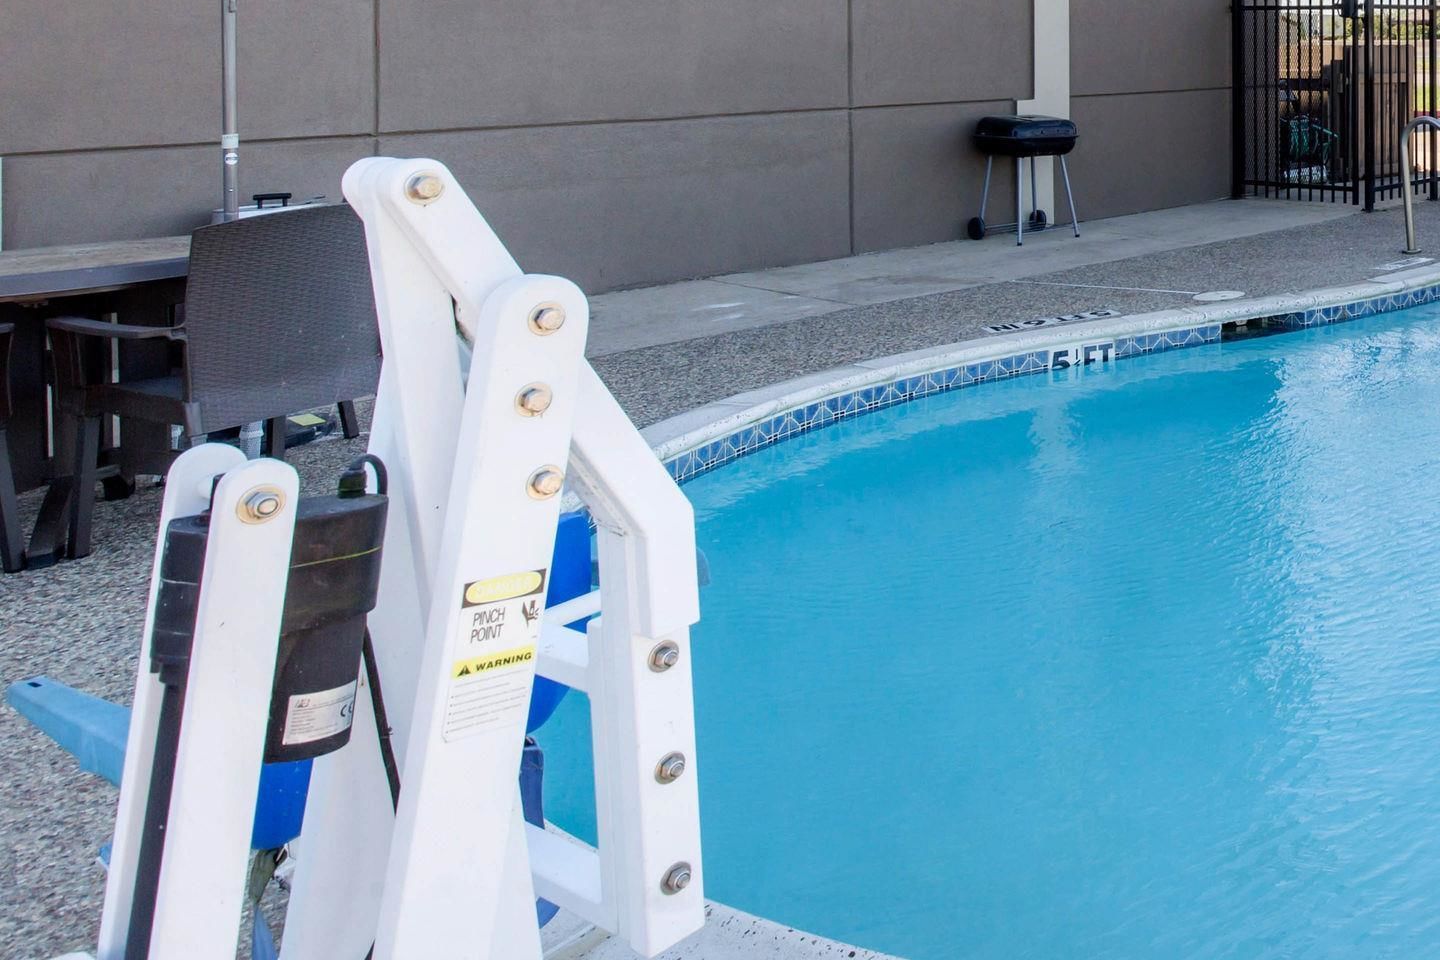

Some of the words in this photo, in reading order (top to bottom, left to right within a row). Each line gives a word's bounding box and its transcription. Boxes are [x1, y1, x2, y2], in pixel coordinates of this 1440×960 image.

[1084, 343, 1113, 365] FT
[473, 607, 506, 627] PINCH
[470, 623, 504, 644] POINT
[475, 652, 532, 672] WARNING
